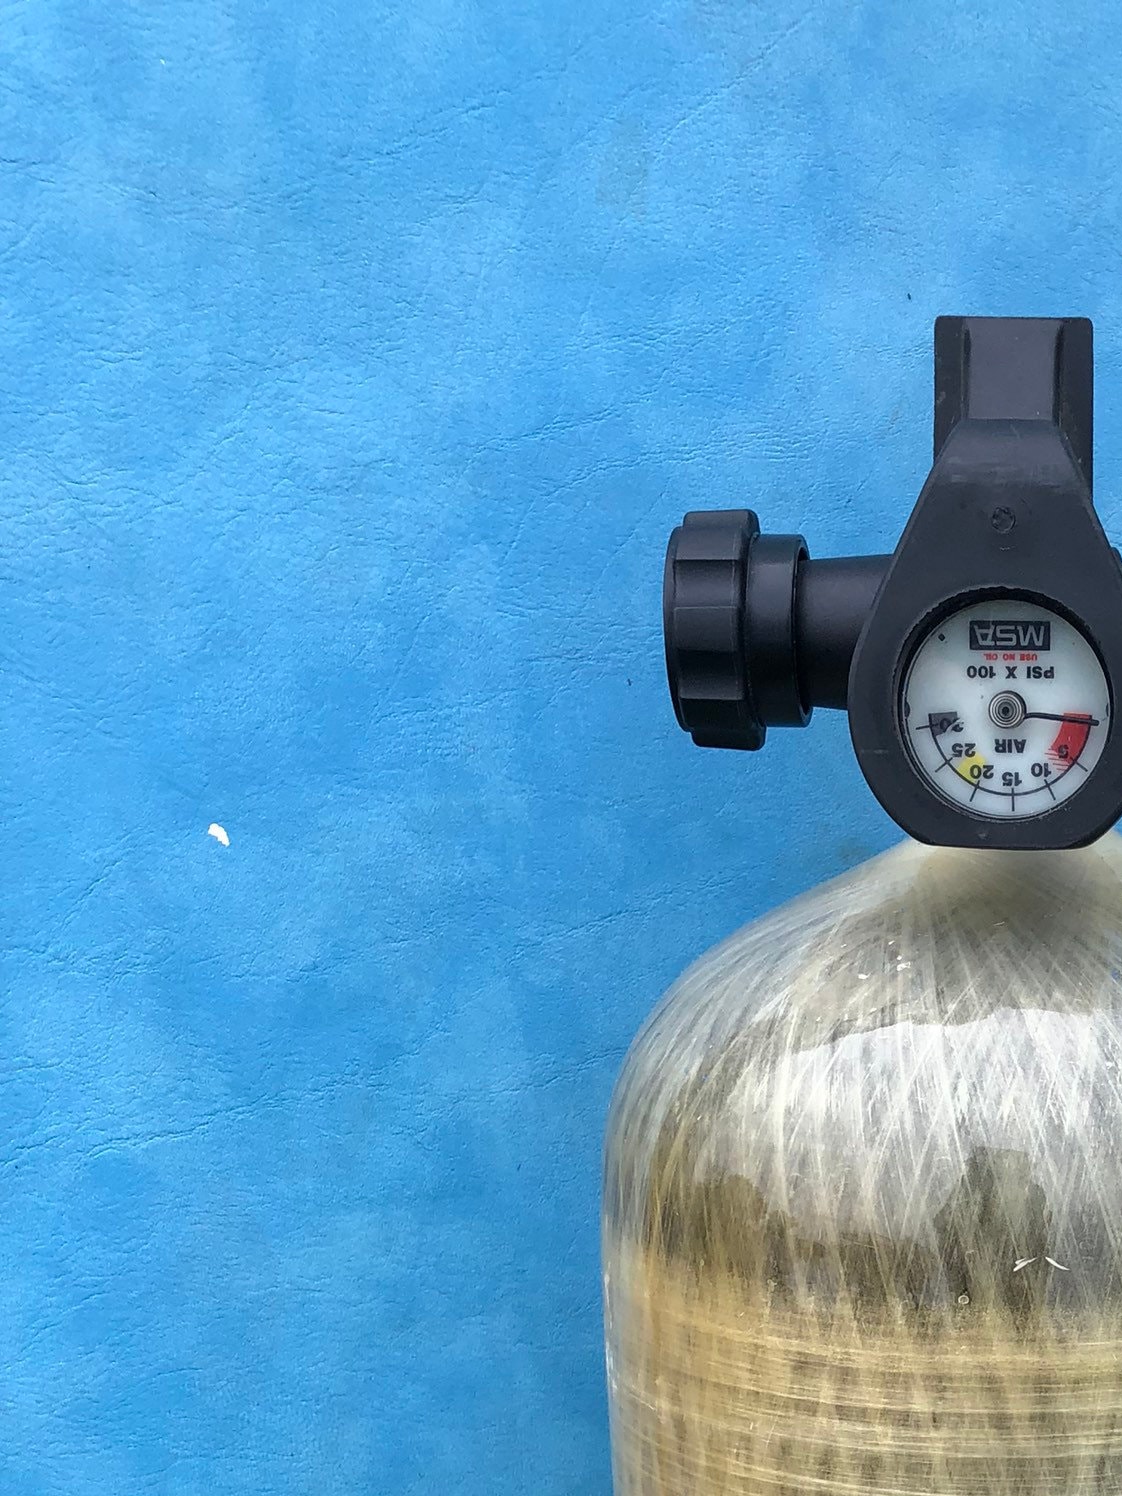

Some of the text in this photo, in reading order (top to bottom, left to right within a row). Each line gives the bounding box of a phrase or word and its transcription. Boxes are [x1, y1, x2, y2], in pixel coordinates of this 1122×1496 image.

[973, 624, 1045, 647] MSA
[1002, 653, 1016, 661] NO
[1020, 653, 1038, 661] USE
[966, 666, 1054, 679] PSI X 100
[951, 743, 976, 758] 25
[994, 739, 1026, 754] AIR
[1058, 744, 1069, 758] 5
[969, 764, 994, 780] 20
[1030, 762, 1052, 778] 10
[1001, 772, 1022, 786] 15
